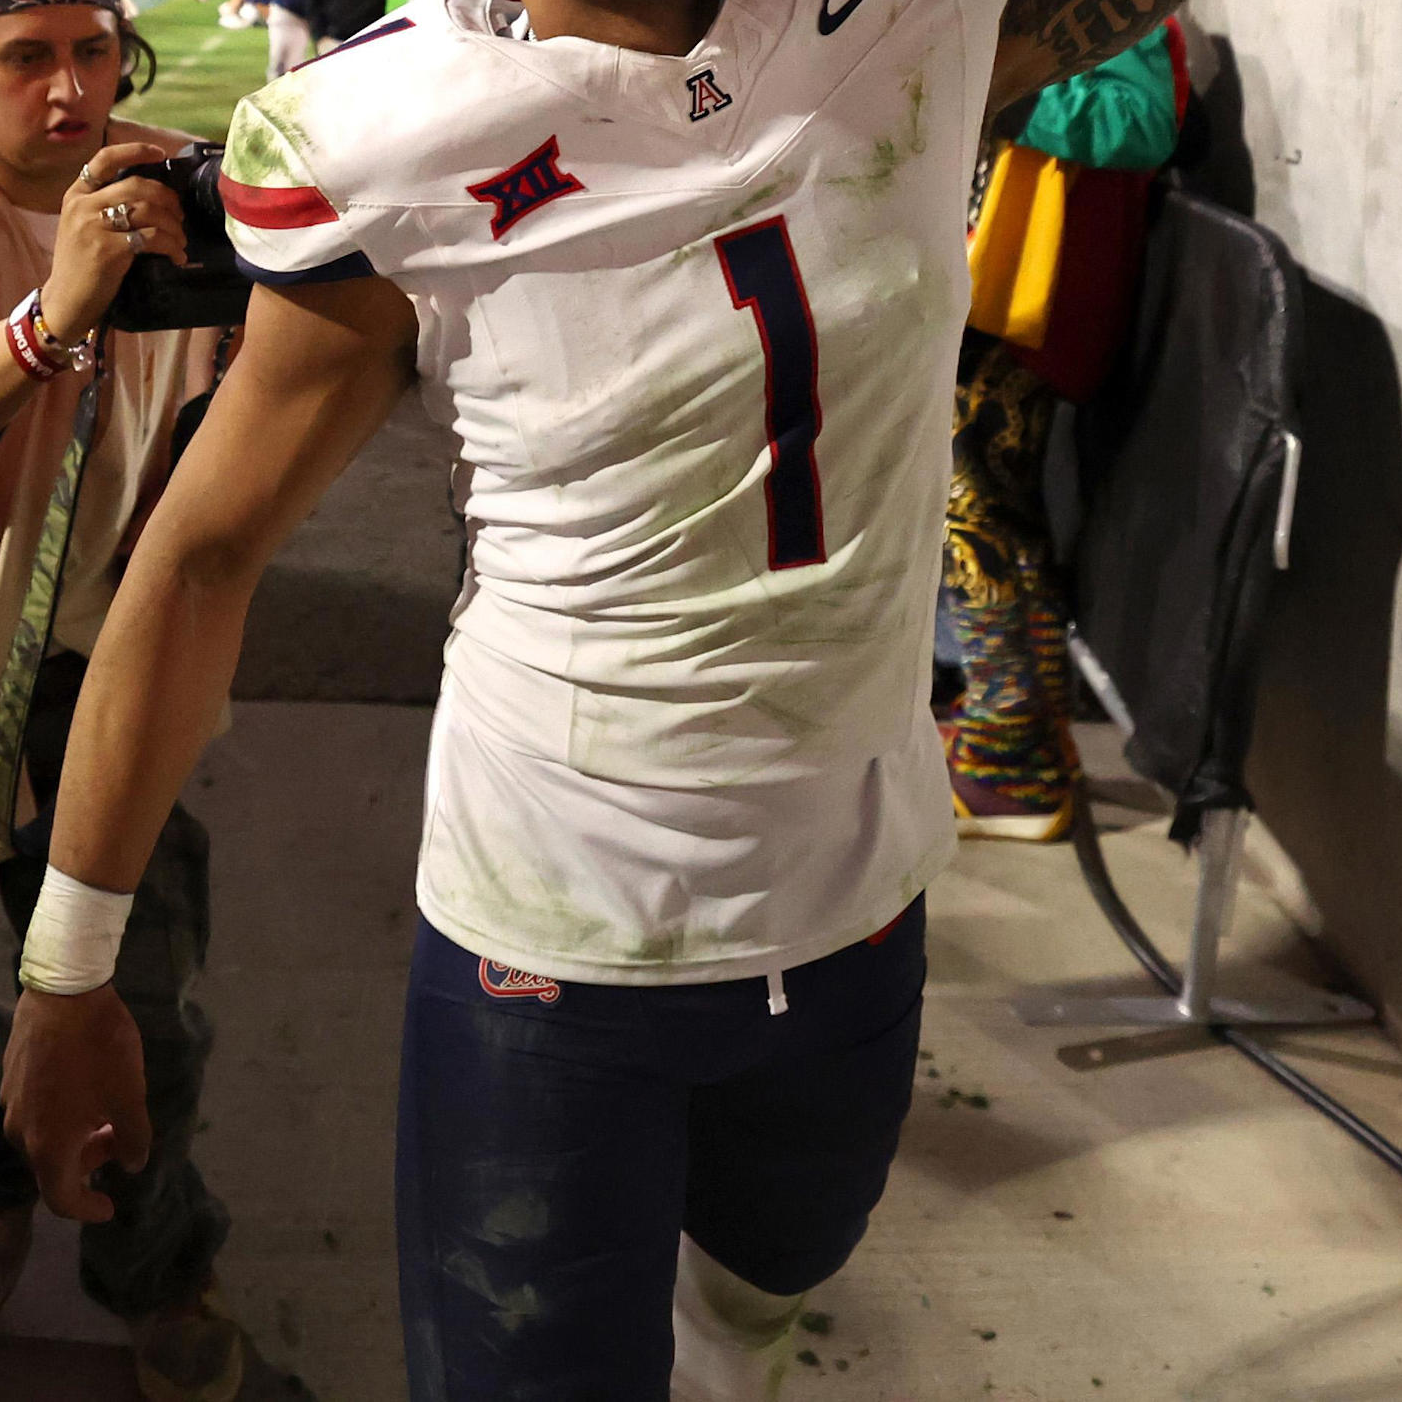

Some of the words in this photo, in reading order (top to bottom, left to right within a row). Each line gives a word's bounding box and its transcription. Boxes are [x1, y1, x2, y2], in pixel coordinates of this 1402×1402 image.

[686, 69, 733, 122] A
[468, 137, 582, 238] XII
[11, 324, 28, 350] DAY
[715, 214, 827, 571] 1
